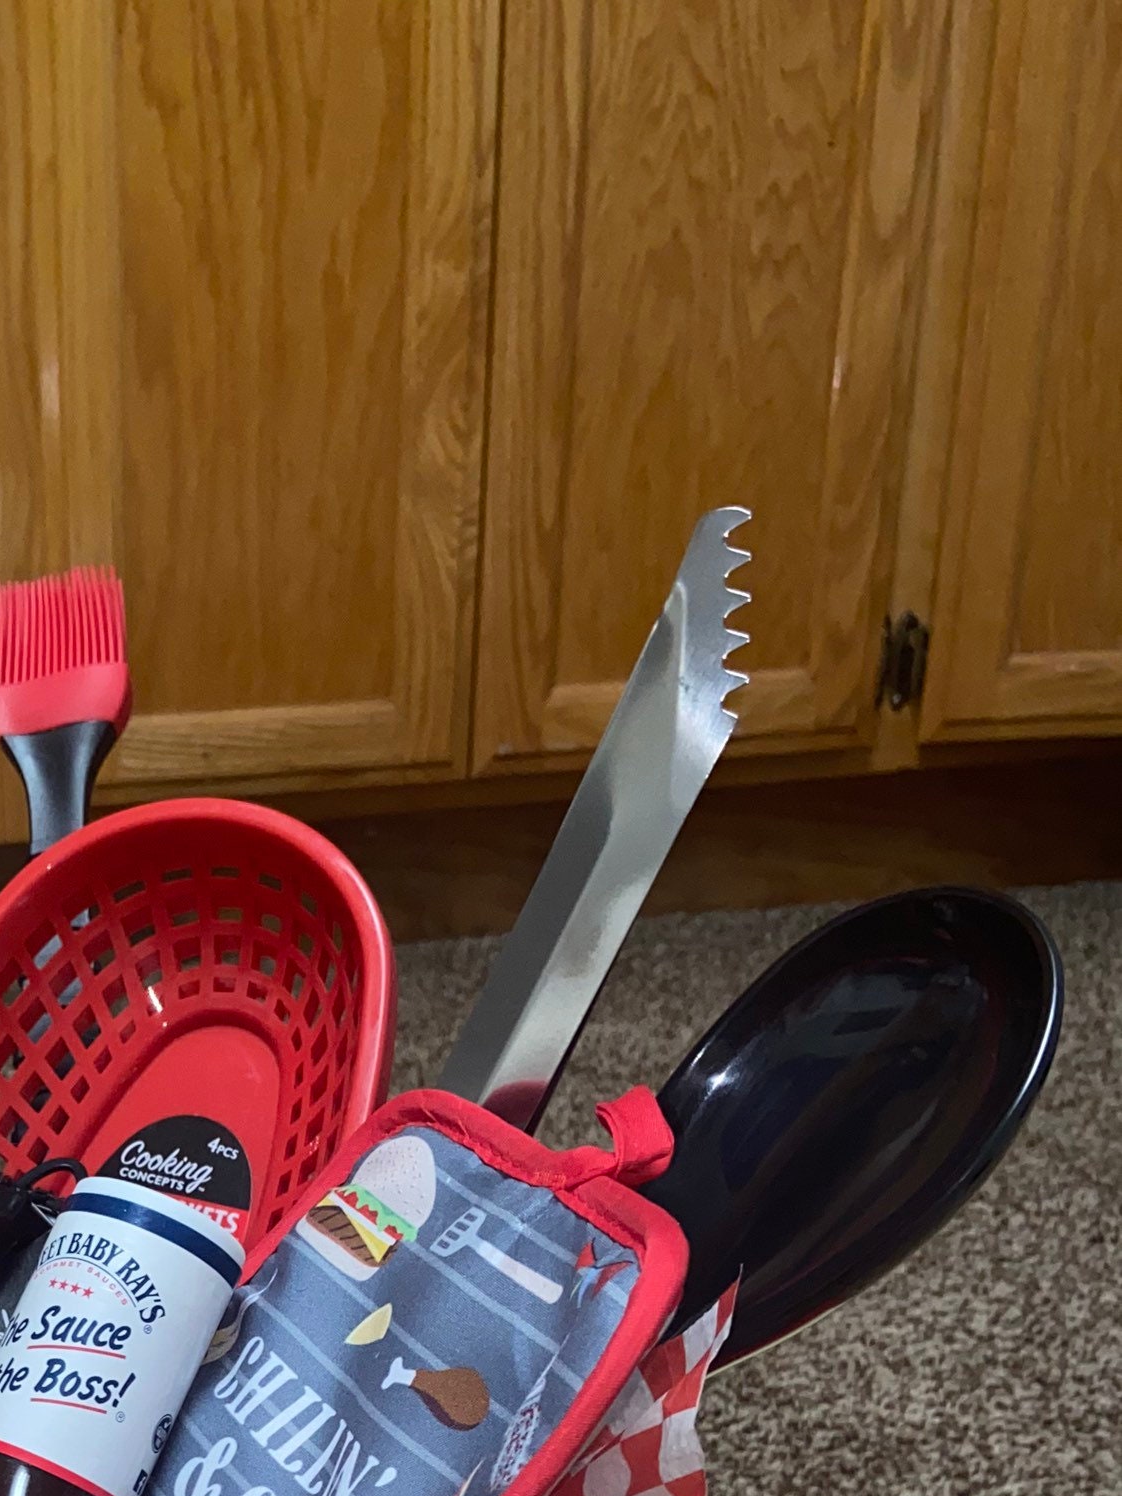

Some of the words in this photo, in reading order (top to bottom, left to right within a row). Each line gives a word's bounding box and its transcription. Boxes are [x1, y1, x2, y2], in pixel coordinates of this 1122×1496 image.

[120, 1140, 213, 1194] Cooking
[207, 1137, 239, 1160] 4PCS
[119, 1167, 185, 1192] CONCEPTS
[40, 1235, 67, 1265] EET
[67, 1232, 125, 1267] BABY
[115, 1257, 166, 1323] RAY'S
[31, 1305, 131, 1350] Sauce
[34, 1358, 136, 1408] Boss!
